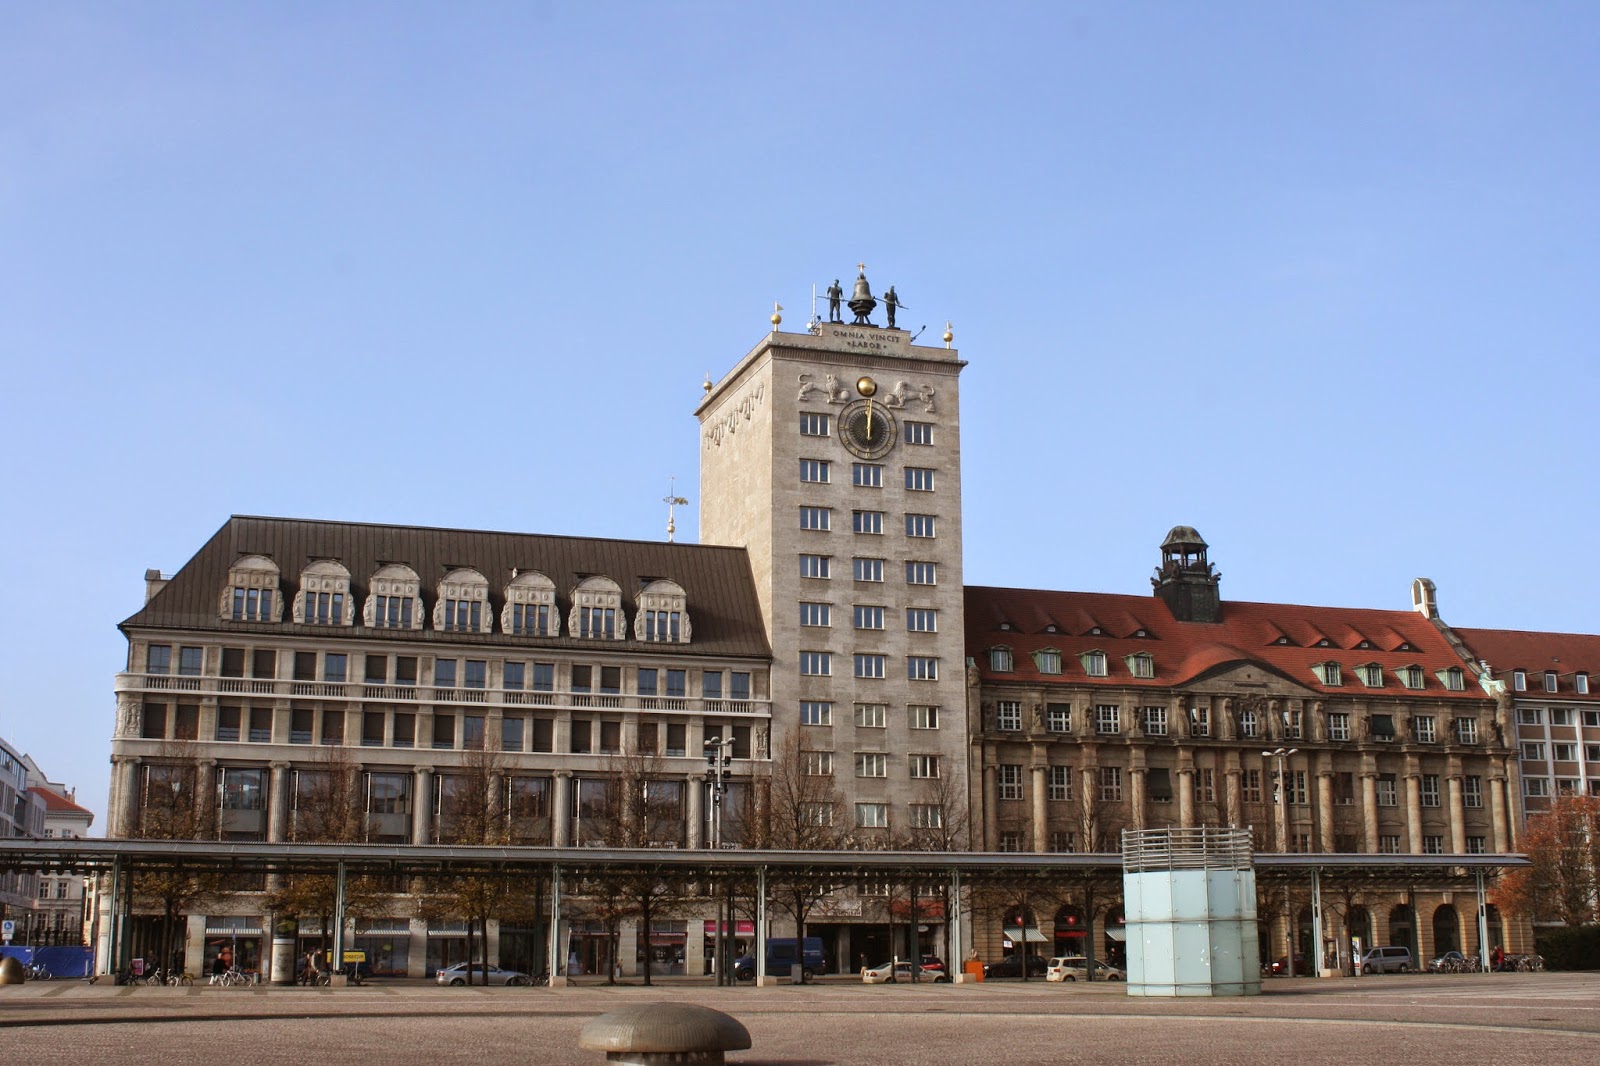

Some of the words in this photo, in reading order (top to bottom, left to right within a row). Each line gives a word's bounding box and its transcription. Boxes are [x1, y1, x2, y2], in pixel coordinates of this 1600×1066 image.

[833, 330, 865, 339] OMNIA
[869, 333, 900, 343] VINCIT
[852, 341, 881, 349] LABOR
